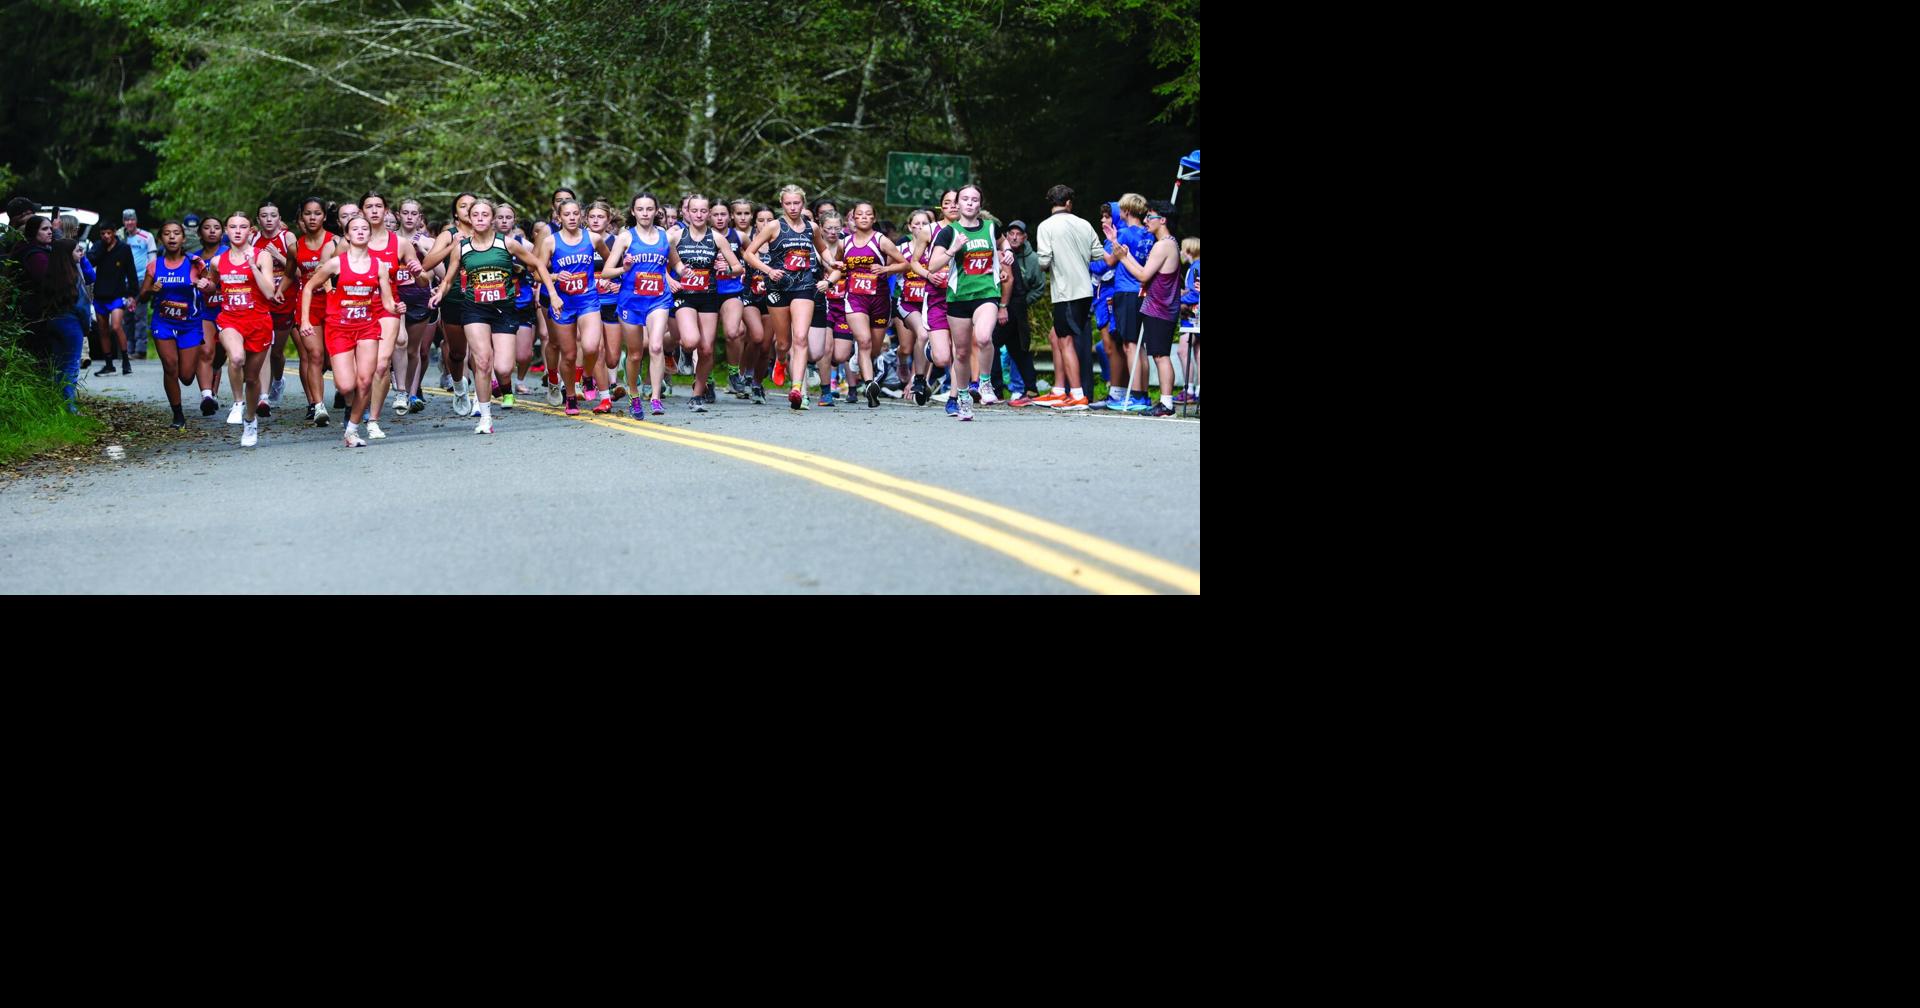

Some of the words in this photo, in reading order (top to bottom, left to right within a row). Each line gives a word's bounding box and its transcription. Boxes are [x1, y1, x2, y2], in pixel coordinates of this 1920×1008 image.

[904, 161, 954, 178] Ward
[897, 182, 944, 200] Cree
[557, 254, 593, 268] WOLVES
[632, 253, 668, 266] WOLVES
[969, 258, 989, 270] 747
[396, 270, 410, 281] 65
[479, 271, 503, 283] CHS
[565, 279, 584, 291] 718
[640, 280, 659, 291] 721
[854, 279, 872, 290] 743
[228, 294, 248, 306] 751
[480, 289, 501, 302] 769
[164, 306, 182, 317] 744
[346, 306, 367, 319] 753
[622, 310, 629, 320] S
